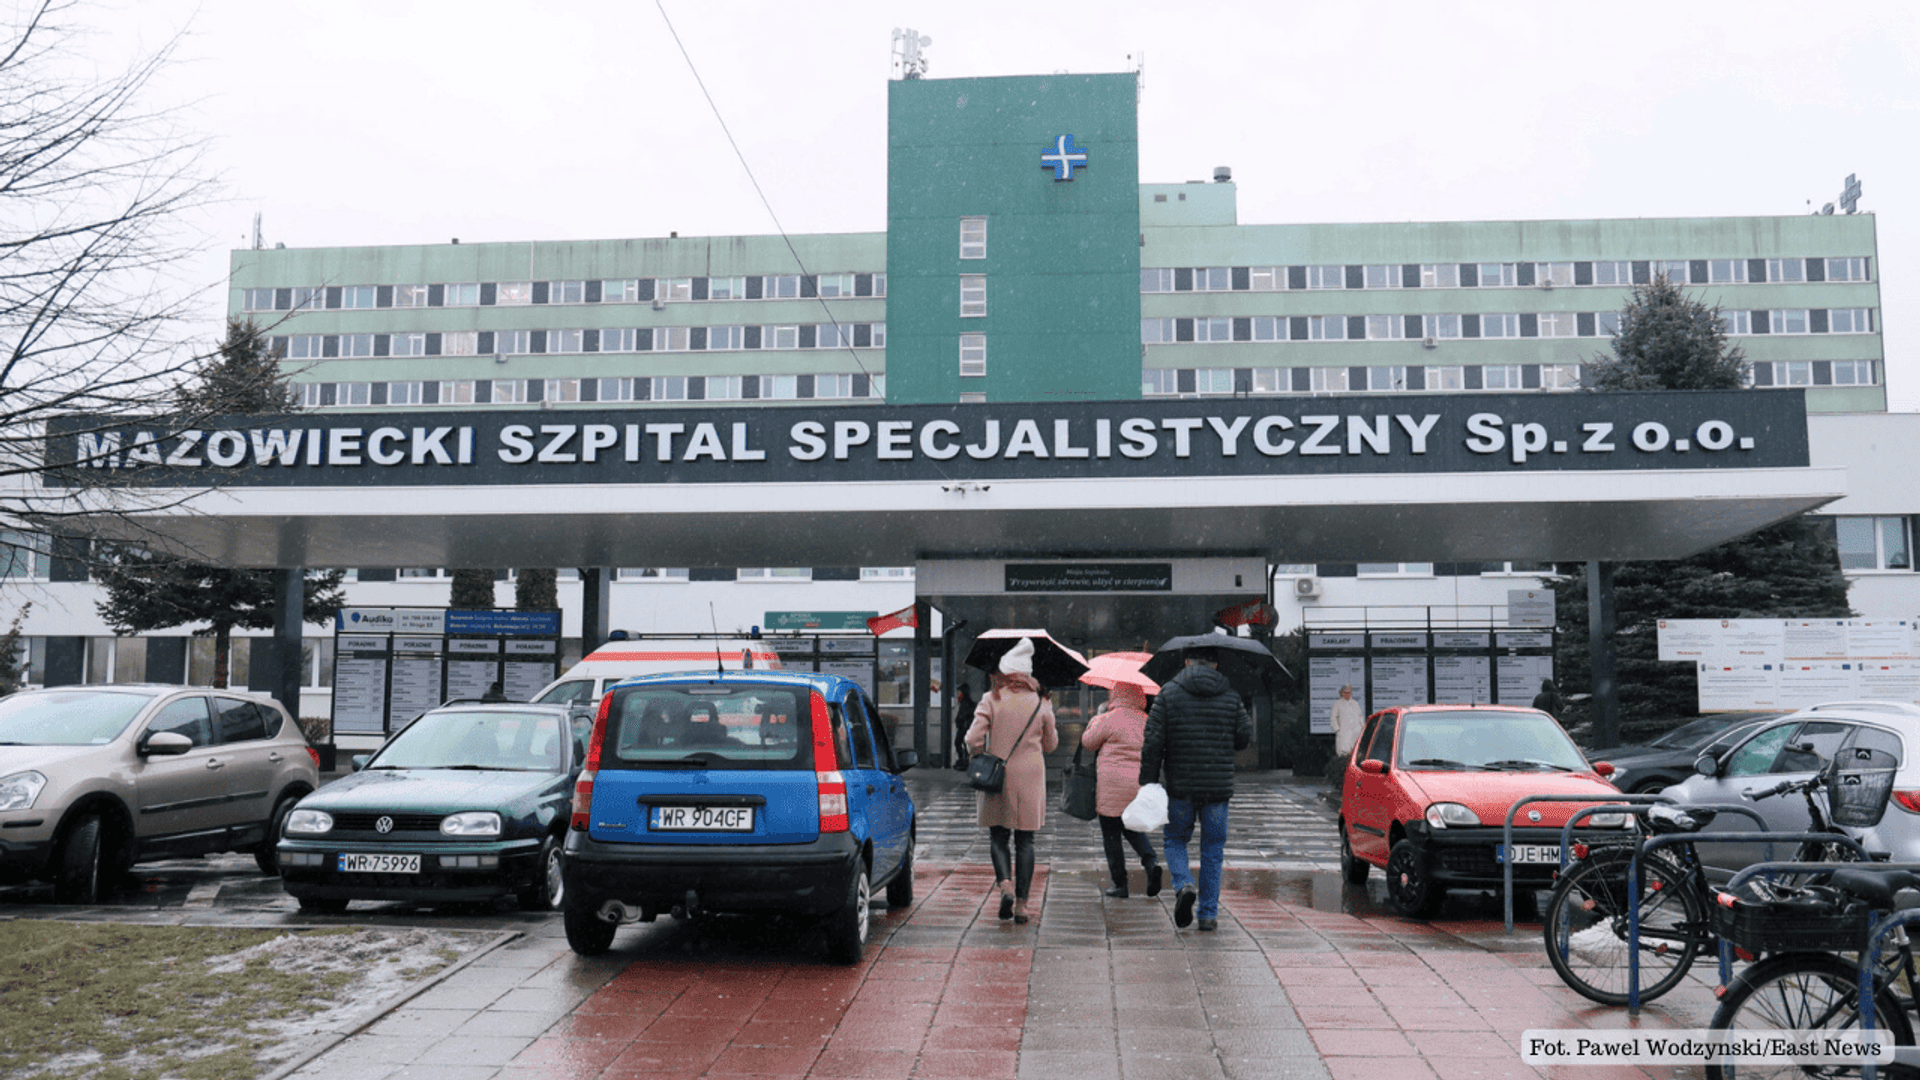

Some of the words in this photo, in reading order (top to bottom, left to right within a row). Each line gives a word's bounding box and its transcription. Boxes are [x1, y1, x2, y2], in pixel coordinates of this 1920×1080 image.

[77, 427, 473, 467] MAZOWIECKI
[497, 423, 765, 463] SZPITAL
[788, 415, 1441, 460] SPECJALISTYCZNY
[1466, 413, 1568, 462] Sp.
[1582, 422, 1615, 452] z
[1632, 420, 1755, 451] o.o.
[662, 809, 686, 827] WR
[692, 809, 748, 827] 904CF
[347, 855, 368, 870] WR
[373, 856, 418, 871] 75996
